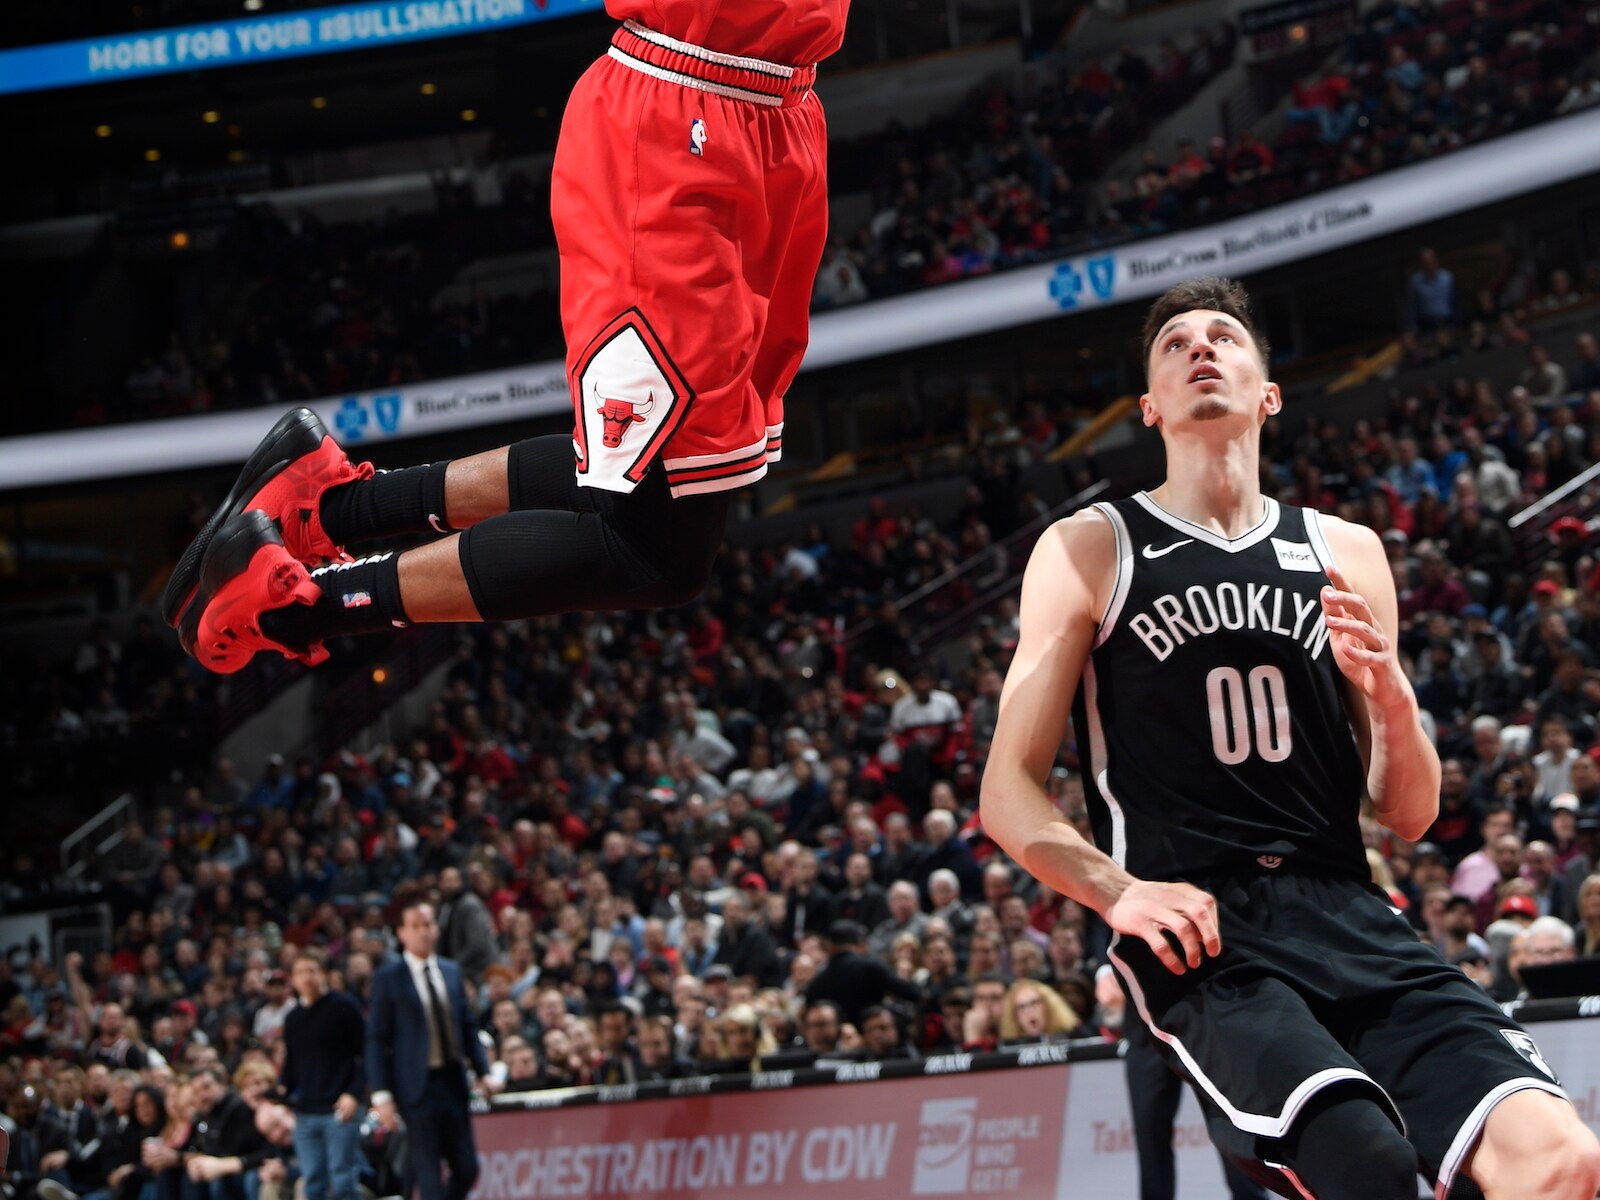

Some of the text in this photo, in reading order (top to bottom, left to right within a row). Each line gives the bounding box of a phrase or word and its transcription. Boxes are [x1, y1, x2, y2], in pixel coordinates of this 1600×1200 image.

[89, 36, 168, 74] MORE
[174, 28, 230, 61] FOR
[235, 18, 312, 55] YOUR
[1278, 548, 1310, 561] infor
[1129, 582, 1330, 662] BROOKLYN
[1206, 664, 1292, 765] 00
[744, 1129, 798, 1186] BY
[801, 1122, 897, 1184] CDW
